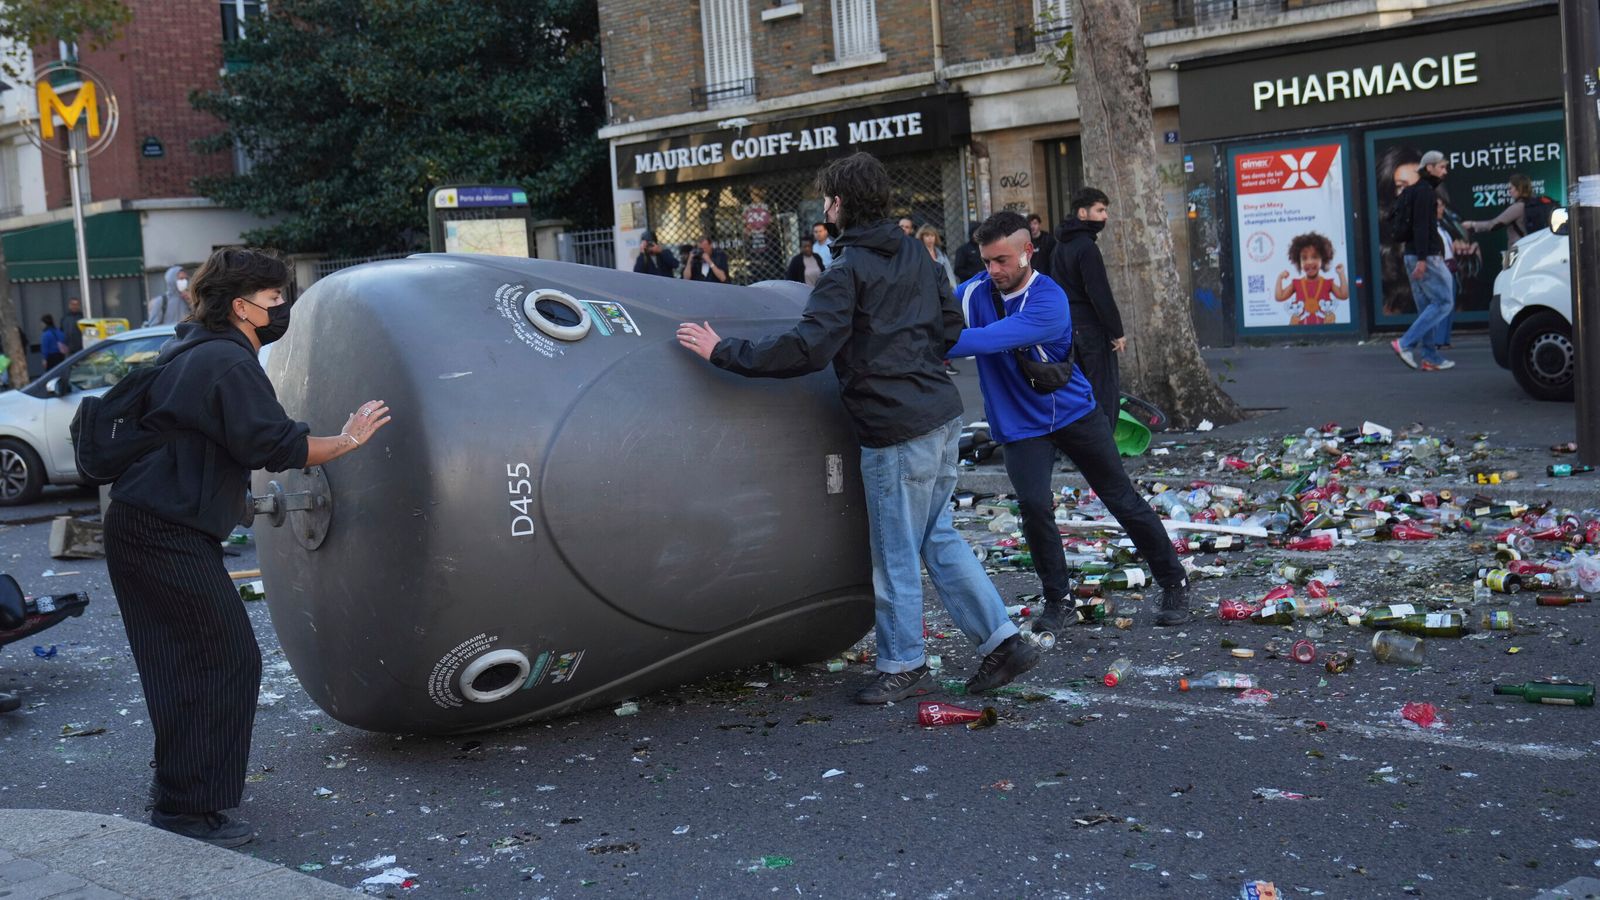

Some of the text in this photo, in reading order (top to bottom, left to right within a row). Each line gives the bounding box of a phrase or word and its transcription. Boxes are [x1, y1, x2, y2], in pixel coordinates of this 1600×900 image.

[1253, 51, 1478, 111] PHARMACIE
[37, 80, 101, 139] M
[635, 112, 923, 174] MAURICE COIFF-AIR MIXTE
[1168, 132, 1176, 143] 2
[1242, 159, 1268, 169] elmex
[1450, 143, 1560, 169] FURTERER
[1251, 171, 1266, 179] dents
[1483, 182, 1511, 190] CHEVEU
[460, 194, 475, 202] Porte
[483, 193, 509, 202] Montreuil
[1473, 191, 1497, 207] 2X
[1244, 217, 1277, 226] champions
[1287, 215, 1316, 223] brossage
[535, 346, 553, 358] POUR
[506, 462, 534, 537] D455
[440, 653, 452, 664] DES
[451, 632, 486, 654] RIVERAINS
[463, 643, 491, 660] HEURES
[437, 667, 448, 681] JETER
[446, 656, 458, 667] VOS
[458, 635, 498, 657] BOUTEILLES
